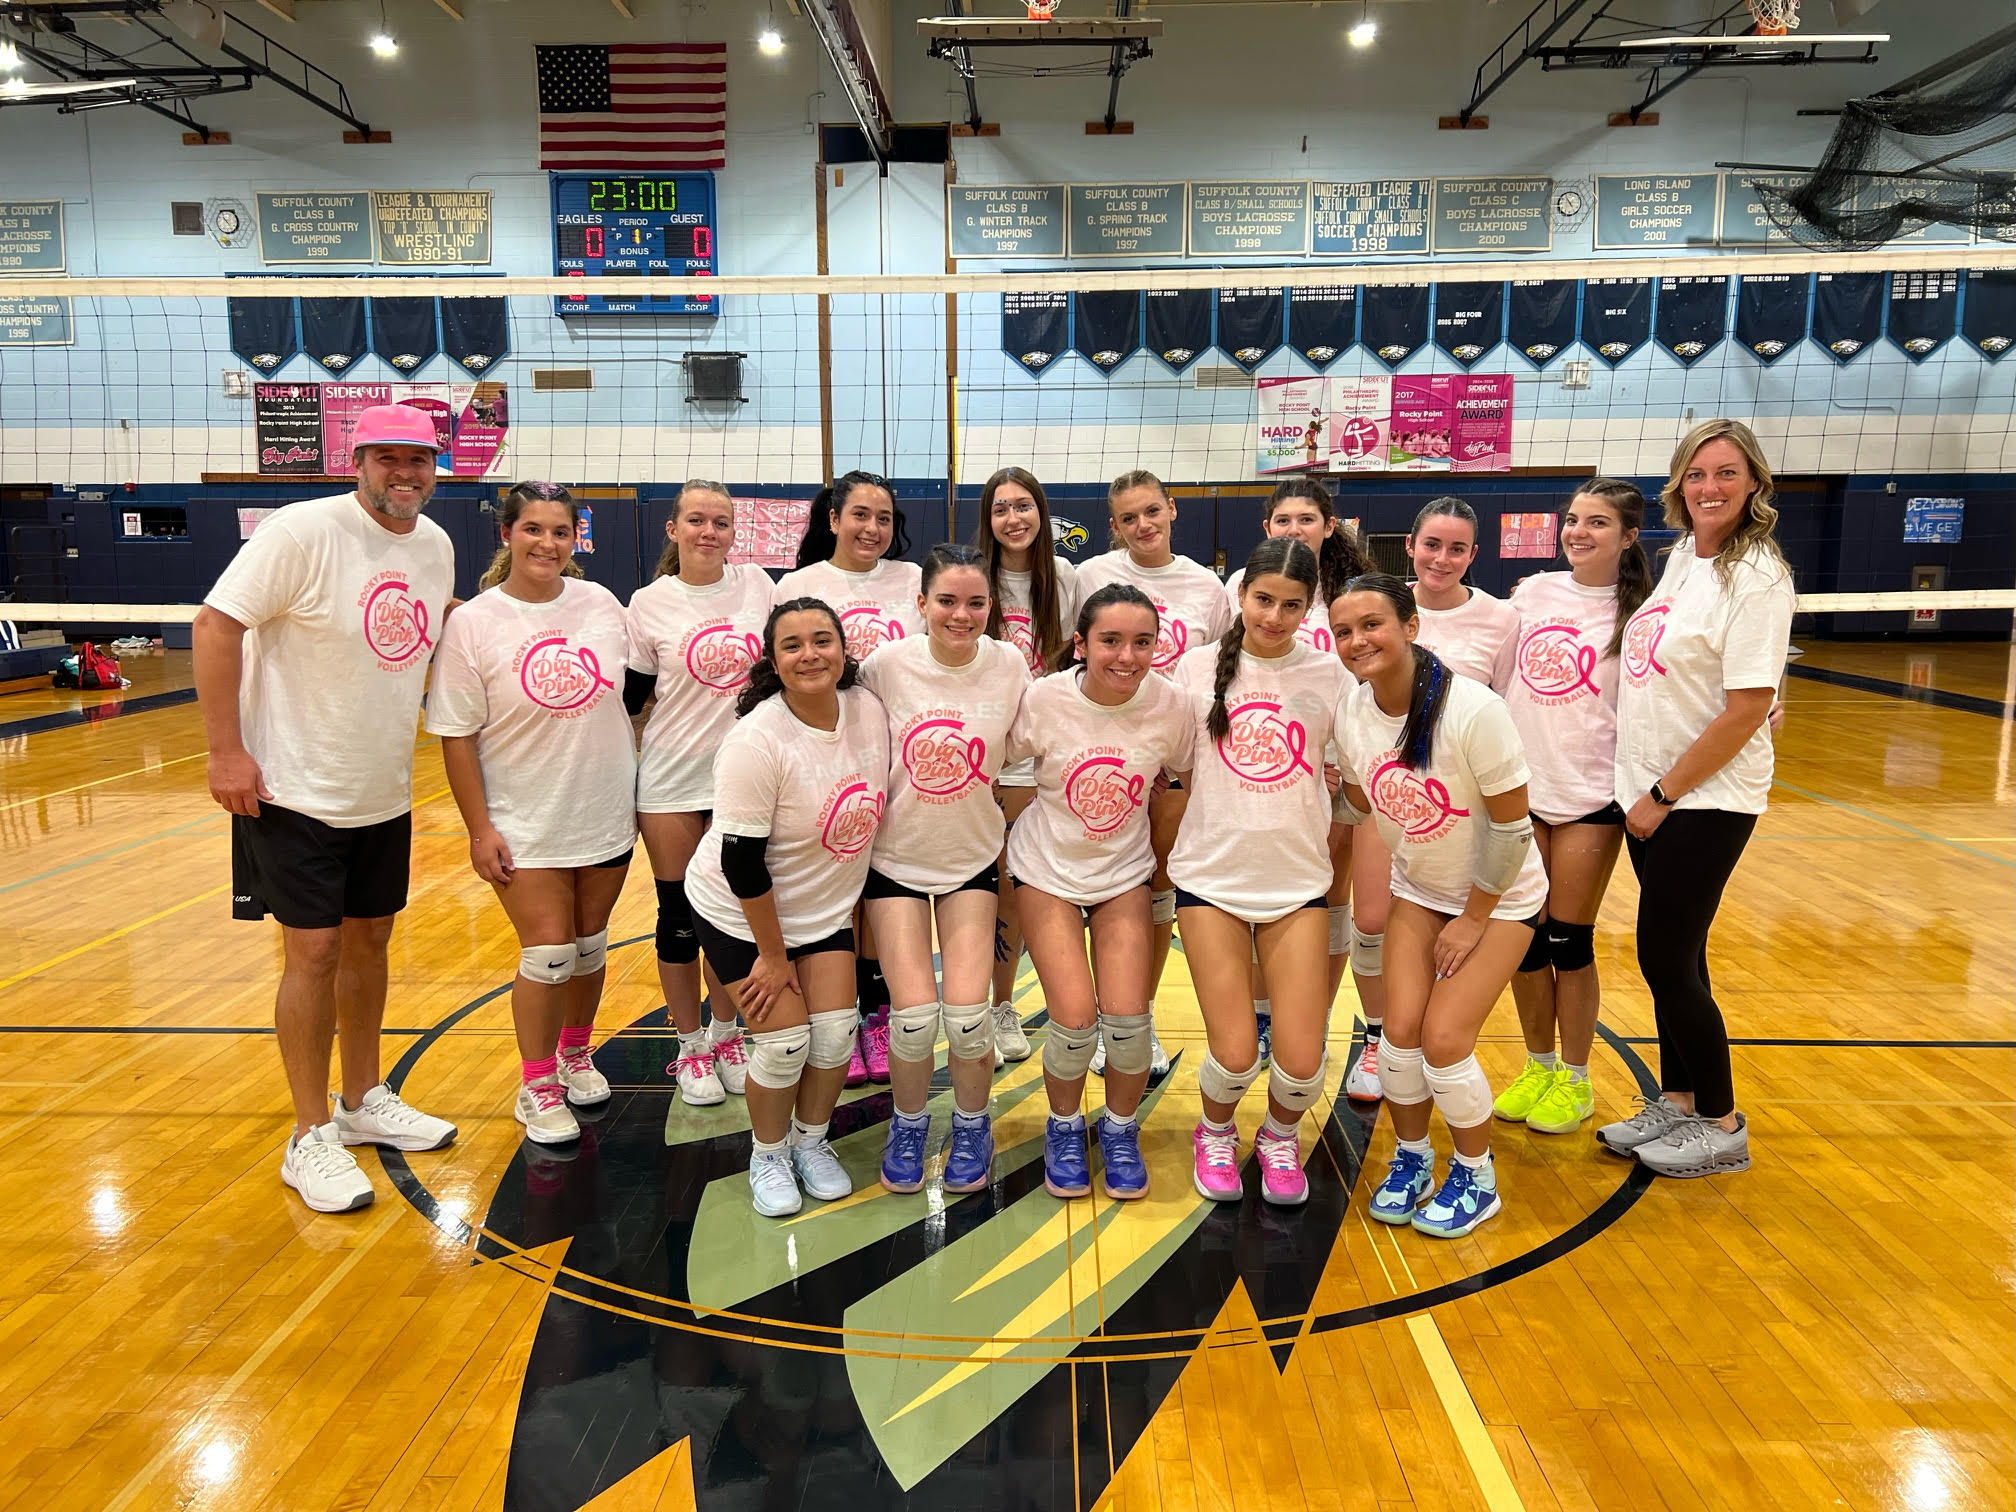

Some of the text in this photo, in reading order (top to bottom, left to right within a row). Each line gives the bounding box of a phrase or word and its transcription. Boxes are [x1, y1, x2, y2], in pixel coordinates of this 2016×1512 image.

[1198, 186, 1300, 196] SUFFOLK COUNTY
[1315, 182, 1428, 197] UNDEFEATED LEAGUE VI
[1443, 181, 1546, 192] SUFFOLK COUNTY
[1624, 180, 1691, 190] LONG ISLAND
[591, 182, 675, 210] 23:00
[965, 191, 1048, 200] SUFFOLK COUNTY
[1085, 189, 1169, 199] SUFFOLK COUNTY
[1636, 193, 1679, 202] CLASS B
[272, 198, 354, 207] SUFFOLK COUNTY
[377, 194, 487, 207] LEAGUE & TOURNAMENT
[1106, 202, 1147, 211] CLASS B
[1195, 200, 1303, 209] CLASS B/SMALL SCHOOLS
[1320, 197, 1347, 211] SUFFOLK
[1356, 197, 1380, 210] COUNTY
[1389, 196, 1409, 209] CLASS
[1470, 196, 1519, 205] CLASS C
[12, 206, 54, 215] COUNTY
[294, 210, 335, 219] CLASS B
[379, 208, 487, 220] UNDEFEATED CHAMPIONS
[986, 204, 1028, 213] CLASS B
[1447, 208, 1541, 219] BOYS LACROSSE
[1621, 205, 1692, 216] GIRLS SOCCER
[557, 215, 602, 223] EAGLES
[670, 215, 703, 223] GUEST
[967, 216, 1047, 226] G. WINTER TRACK
[1088, 214, 1167, 224] G. SPRING TRACK
[1202, 212, 1295, 222] BOYS LACROSSE
[1315, 209, 1427, 224] SUFFOLK COUNTY SMALL SCHOOLS
[23, 219, 30, 228] B
[272, 223, 358, 232] G. CROSS COUNTRY
[384, 222, 483, 234] TOP SCHOOL IN COUNTY
[1459, 222, 1527, 232] CHAMPIONS
[1630, 218, 1682, 228] CHAMPIONS
[982, 230, 1032, 238] CHAMPIONS
[1102, 228, 1152, 237] CHAMPIONS
[1216, 225, 1282, 235] CHAMPIONS
[1318, 223, 1422, 238] SOCCER CHAMPIONS
[1644, 232, 1666, 240] 2001
[292, 235, 341, 244] CHAMPIONS
[393, 235, 474, 247] WRESTLING
[586, 228, 603, 256] 0
[694, 227, 711, 256] 0
[1116, 240, 1137, 249] 1997
[1235, 239, 1261, 247] 1998
[1352, 238, 1387, 251] 1998
[1479, 235, 1505, 244] 2000
[307, 248, 328, 256] 1990
[996, 242, 1018, 250] 1997
[407, 248, 462, 260] 1990-91
[19, 305, 59, 313] COUNTRY
[8, 329, 29, 337] 1996
[1456, 400, 1508, 408] ACHIEVEMENT
[1461, 410, 1503, 419] AWARD
[1262, 427, 1303, 437] HARD
[358, 571, 407, 607] ROCKY POINT
[377, 602, 406, 626] Dig
[1551, 618, 1582, 627] POINT
[376, 625, 415, 643] Pink
[678, 618, 728, 656] ROCKY POINT
[845, 624, 880, 645] Dig
[512, 629, 563, 673] ROCKY POINT
[700, 643, 736, 662] Dig
[1530, 639, 1568, 664] Dig
[377, 648, 425, 672] VOLLEYBALL
[534, 658, 570, 678] Dig
[702, 658, 749, 678] Pink
[1527, 659, 1575, 682] Pink
[537, 673, 590, 697] Pink
[1243, 692, 1280, 702] POINT
[1530, 689, 1589, 706] VOLLEYBALL
[550, 689, 606, 719] VOLLEYBALL
[898, 709, 963, 743] ROCKY POINT
[1234, 722, 1275, 747] Dig
[915, 739, 957, 763] Dig
[1232, 744, 1288, 764] Pink
[915, 761, 964, 778] Pink
[1060, 746, 1123, 783] ROCKY POINT
[1366, 755, 1382, 787] ROCKY
[1240, 770, 1304, 793] VOLLEYBALL
[916, 780, 979, 805] VOLLEYBALL
[1080, 778, 1119, 800] Dig
[1381, 781, 1417, 804] Dig
[816, 773, 861, 827] ROCKY POINT
[1078, 799, 1126, 816] Pink
[1386, 801, 1436, 819] Pink
